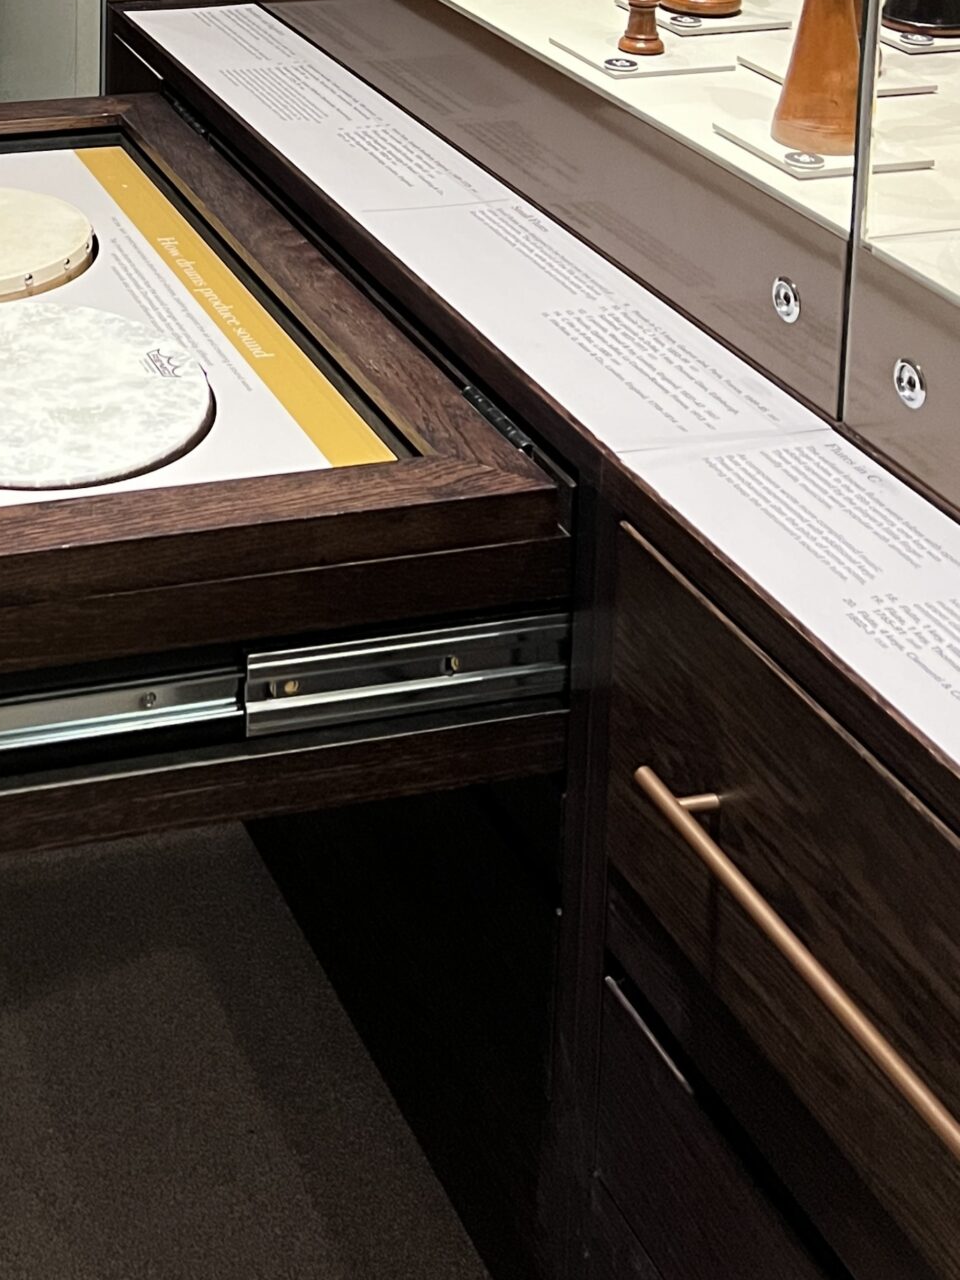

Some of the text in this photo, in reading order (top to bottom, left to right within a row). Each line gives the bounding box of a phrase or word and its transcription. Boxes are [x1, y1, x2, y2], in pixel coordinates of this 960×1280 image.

[157, 236, 276, 358] How drums produce sound
